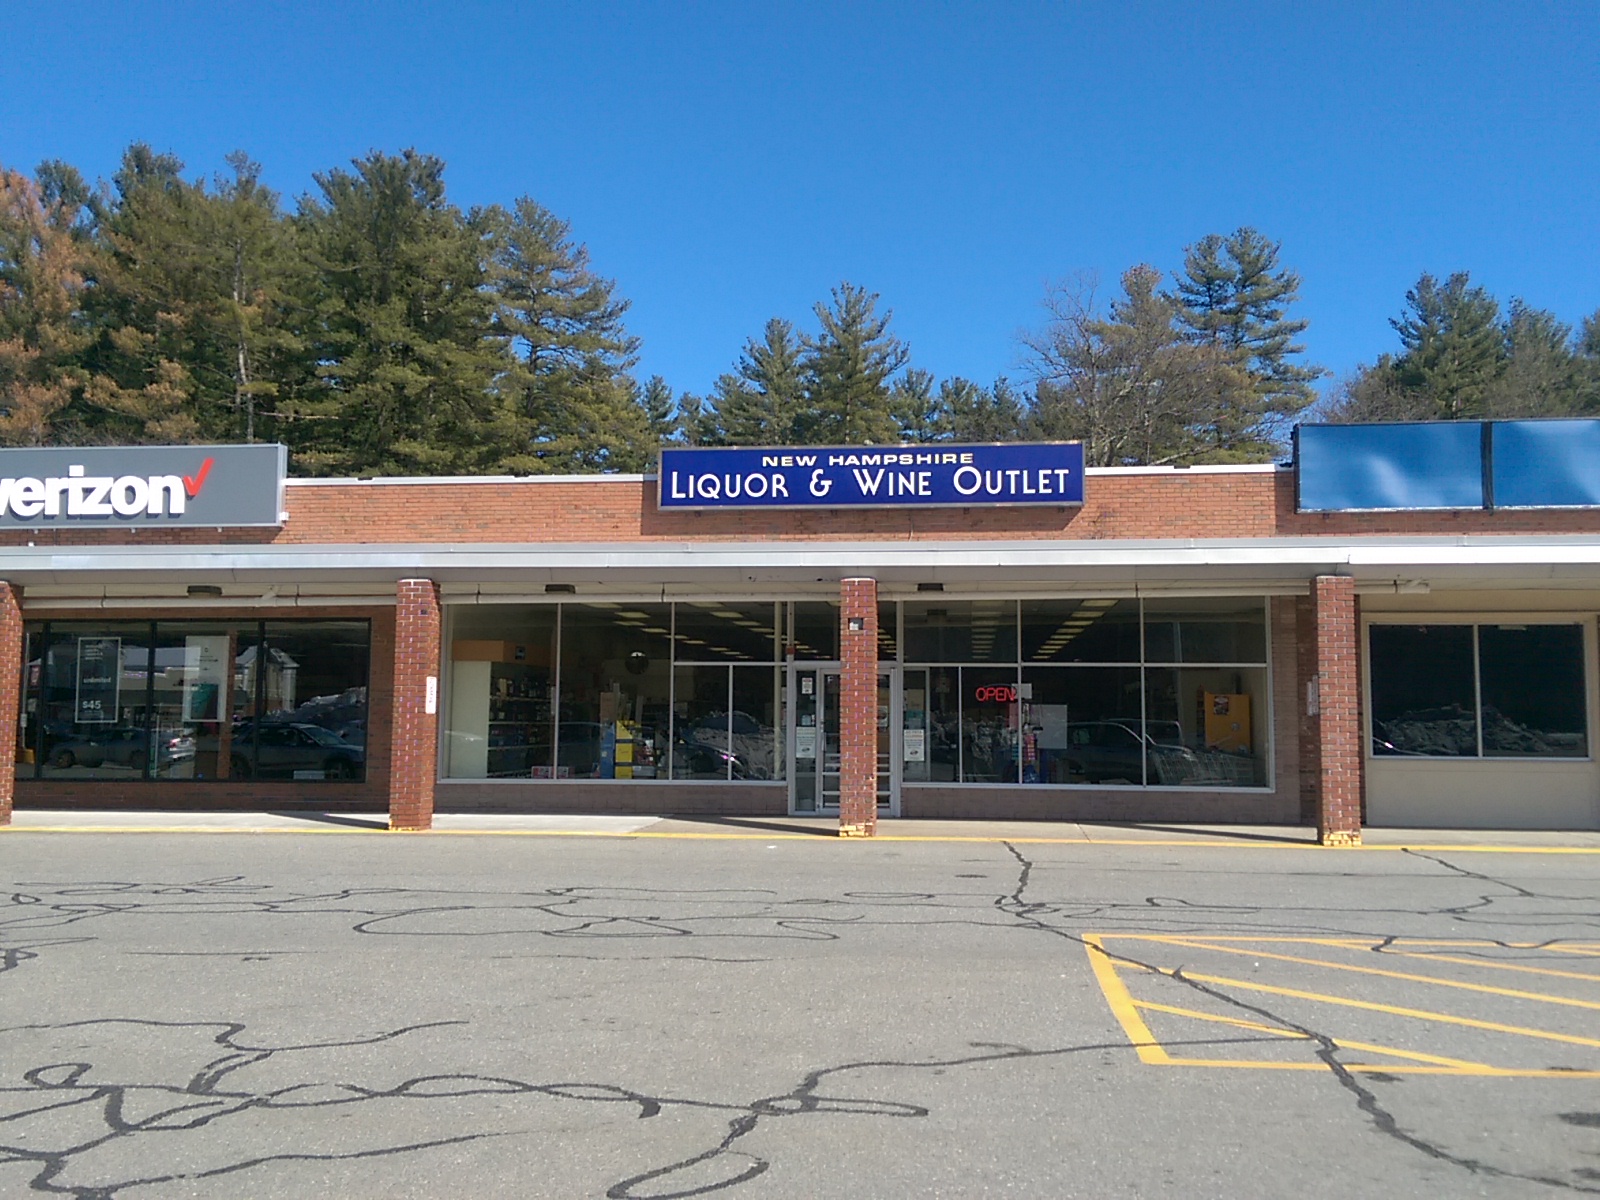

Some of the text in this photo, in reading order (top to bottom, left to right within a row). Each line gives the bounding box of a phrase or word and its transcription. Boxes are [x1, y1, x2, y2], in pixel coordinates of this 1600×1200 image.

[762, 453, 974, 467] NEW HAMPSHIRE
[671, 465, 1070, 499] LIQUOR & WINE OUTLET
[975, 687, 1016, 702] OPEN
